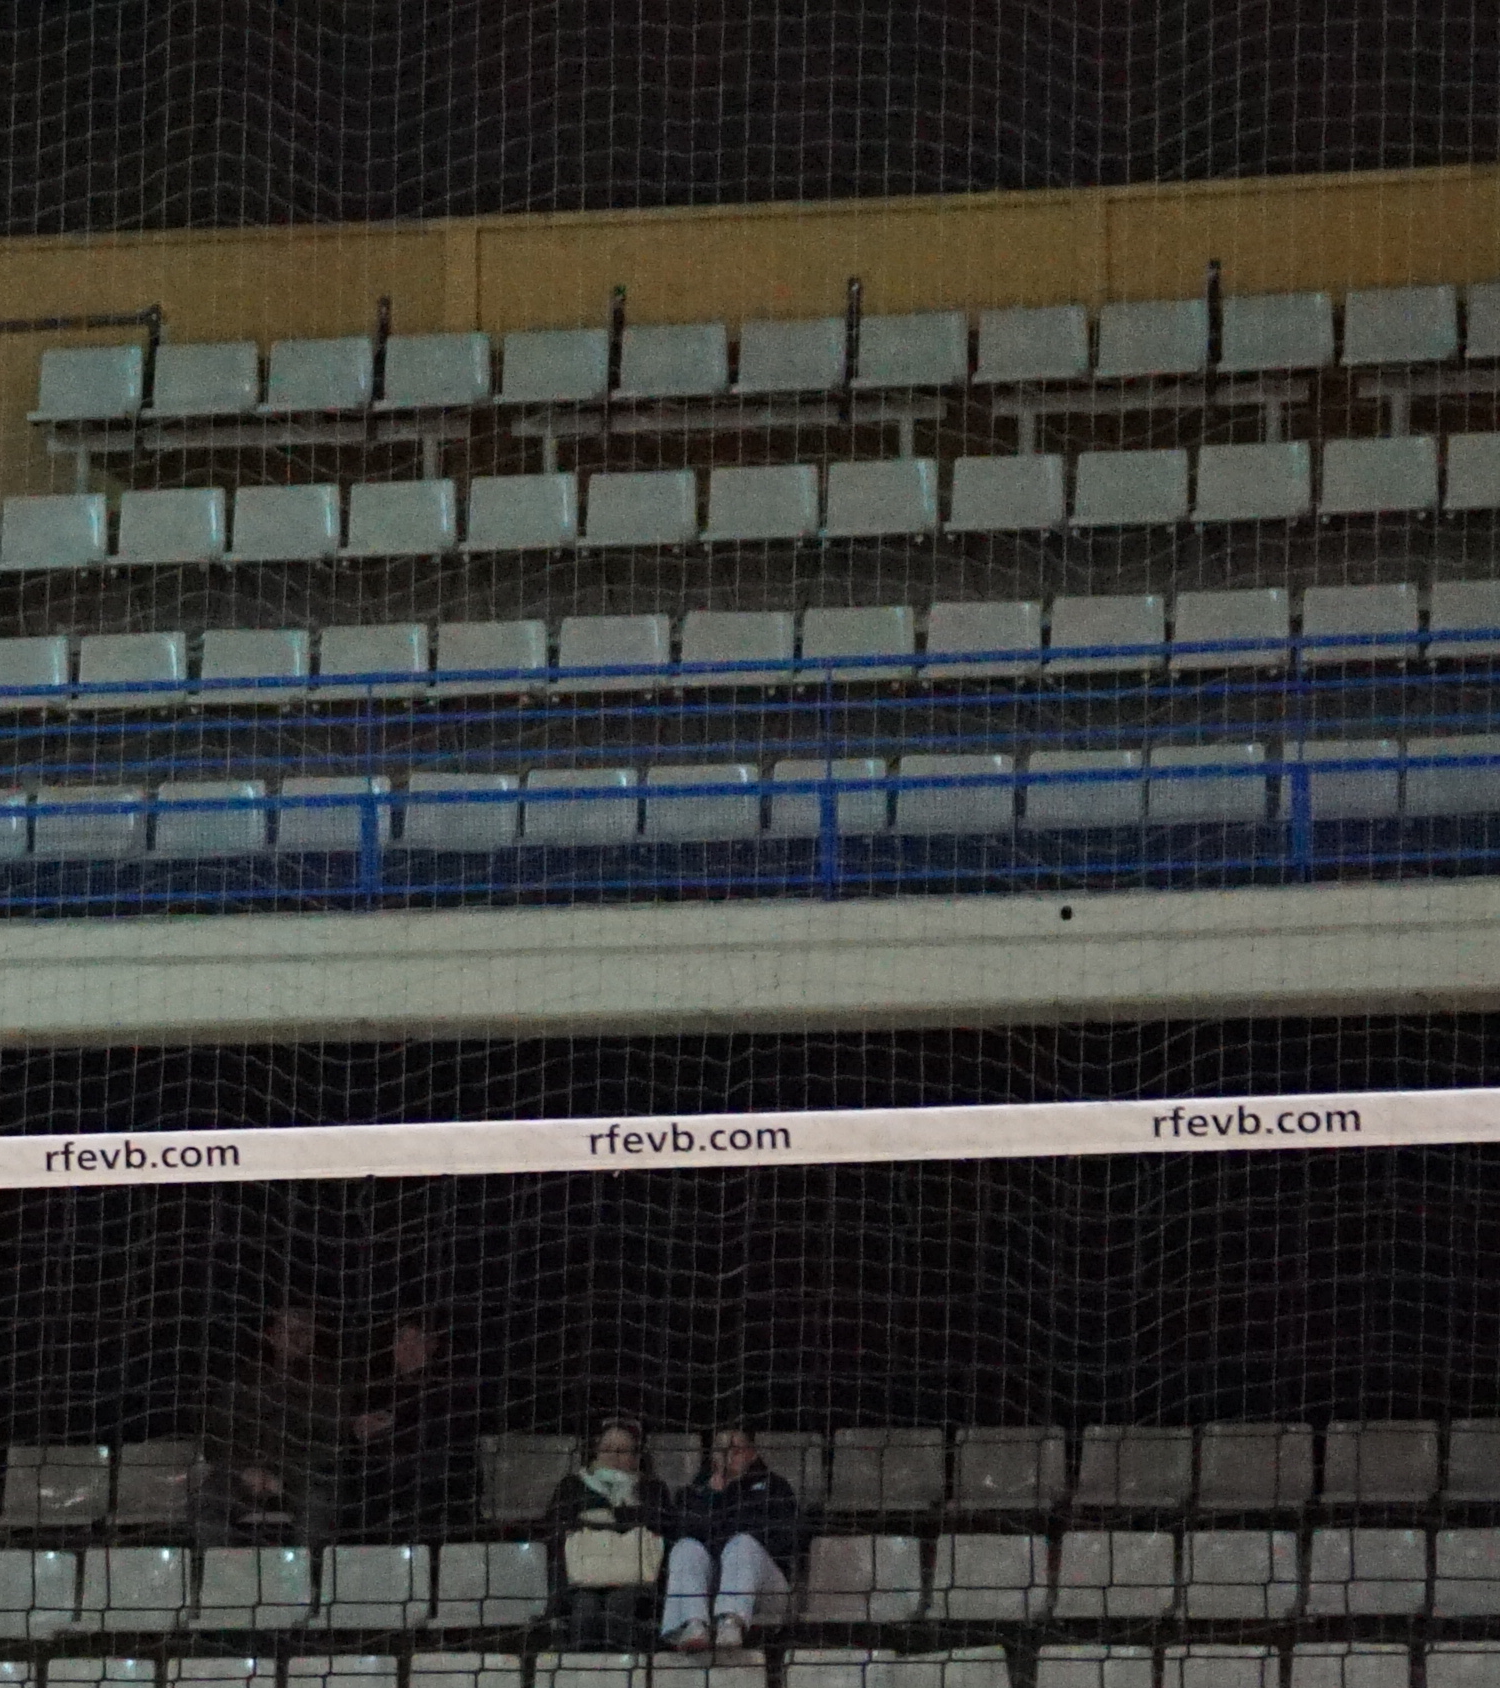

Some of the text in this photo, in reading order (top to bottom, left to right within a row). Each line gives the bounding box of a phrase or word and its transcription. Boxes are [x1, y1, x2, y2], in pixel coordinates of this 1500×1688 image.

[1153, 1105, 1361, 1138] rfevb.com
[589, 1122, 791, 1155] rfevb.com
[46, 1140, 240, 1172] rfevb.com
